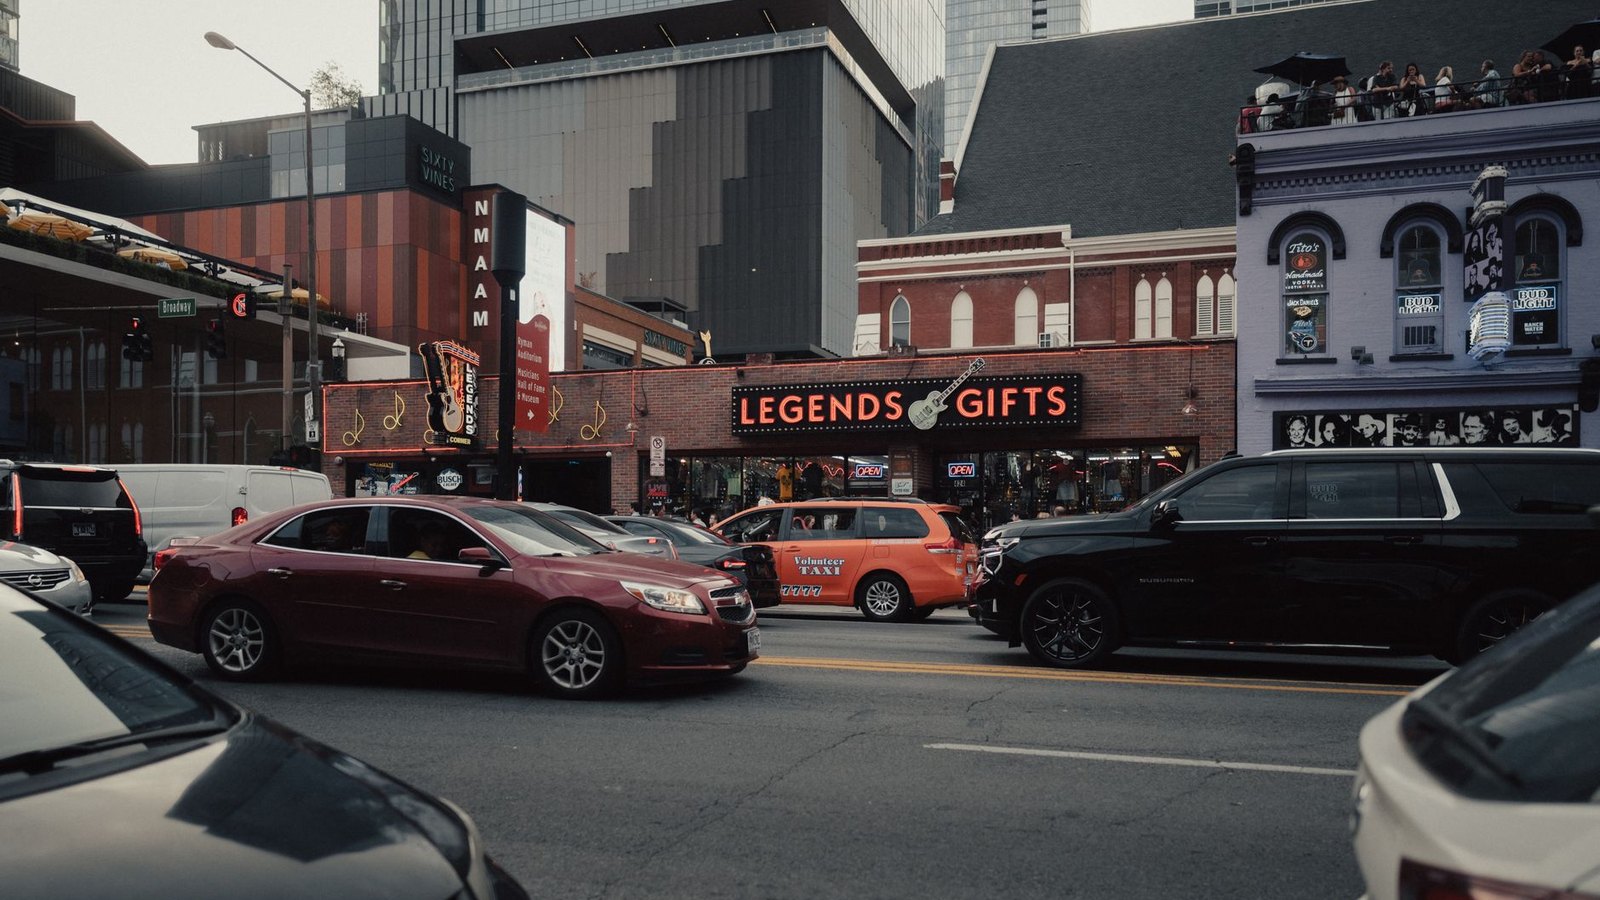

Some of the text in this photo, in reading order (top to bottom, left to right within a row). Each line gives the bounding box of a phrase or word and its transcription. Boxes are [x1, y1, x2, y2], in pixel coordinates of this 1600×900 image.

[422, 147, 454, 174] SIXTY
[421, 163, 456, 192] VINES
[1288, 242, 1320, 254] Tito's
[473, 200, 489, 326] NMAAM
[1285, 269, 1324, 279] Handmade
[1518, 289, 1548, 300] BUD
[162, 300, 192, 315] Broadway
[1404, 296, 1434, 307] BUD
[1512, 299, 1554, 310] LIGHT
[517, 337, 533, 348] Ryman
[517, 349, 543, 364] Auditorium
[517, 367, 540, 381] Musicians
[517, 380, 546, 394] Hall of Fame
[465, 363, 475, 435] LEGENDS
[521, 392, 540, 404] Museum
[740, 385, 1066, 425] LEGENDS GIFTS
[449, 436, 472, 445] CORNER
[857, 466, 881, 476] OPEN
[950, 465, 973, 476] OPEN
[436, 475, 463, 484] BUSCH
[794, 556, 845, 565] Volunteer
[799, 566, 840, 576] TAXI
[780, 584, 823, 597] 7777
